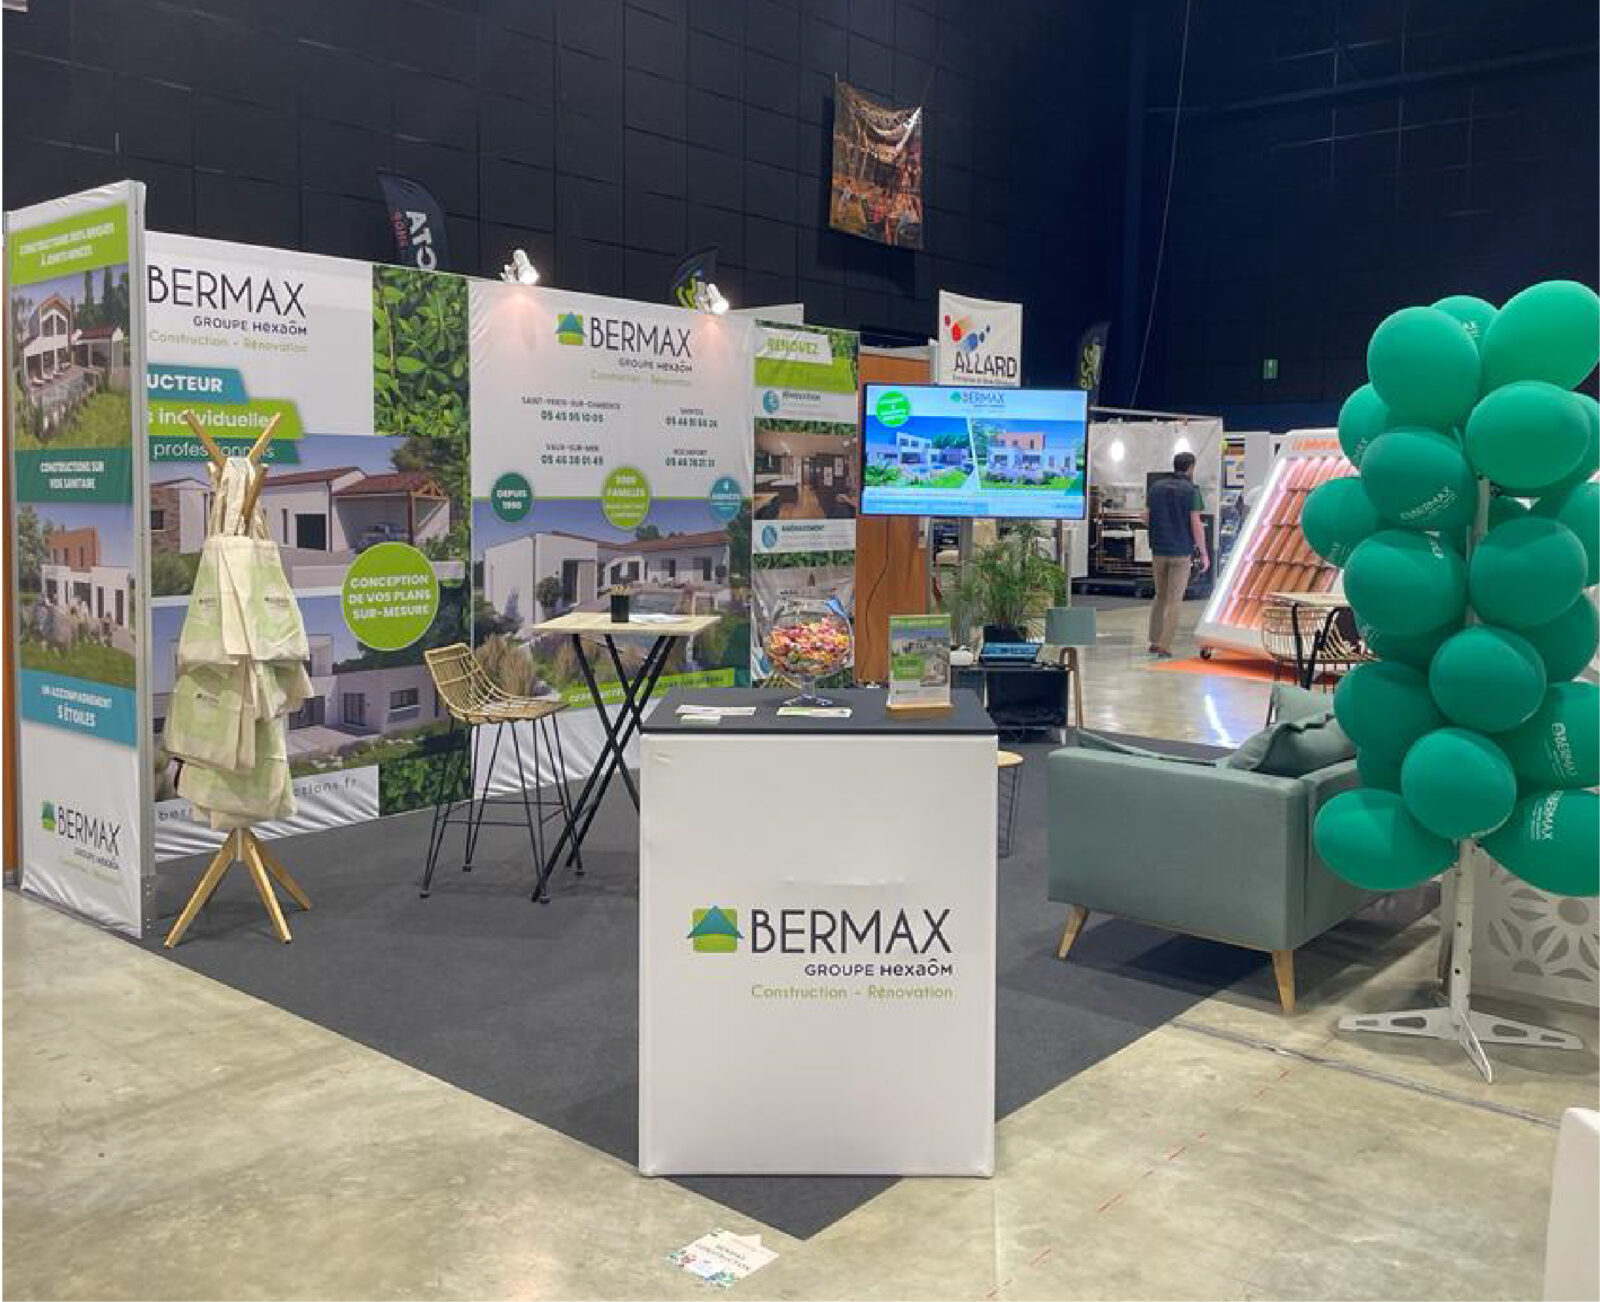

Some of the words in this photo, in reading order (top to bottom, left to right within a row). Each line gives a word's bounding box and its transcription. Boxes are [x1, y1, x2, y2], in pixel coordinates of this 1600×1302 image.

[147, 264, 306, 318] BERMAX
[193, 315, 248, 332] GROUPE
[150, 329, 229, 347] Construction
[243, 337, 309, 353] Rénovation
[590, 317, 692, 358] BERMAX
[954, 351, 1018, 378] ALLARD
[496, 489, 528, 499] DEPUIS
[351, 574, 431, 589] CONCEPTION
[349, 594, 363, 605] DE
[366, 591, 391, 602] VOS
[394, 589, 431, 601] PLANS
[352, 605, 430, 619] SUR-MESURE
[58, 805, 121, 856] BERMAX
[751, 907, 953, 954] BERMAX
[804, 963, 874, 977] GROUPE
[751, 984, 848, 999] Construction
[867, 984, 953, 999] Rénovation
